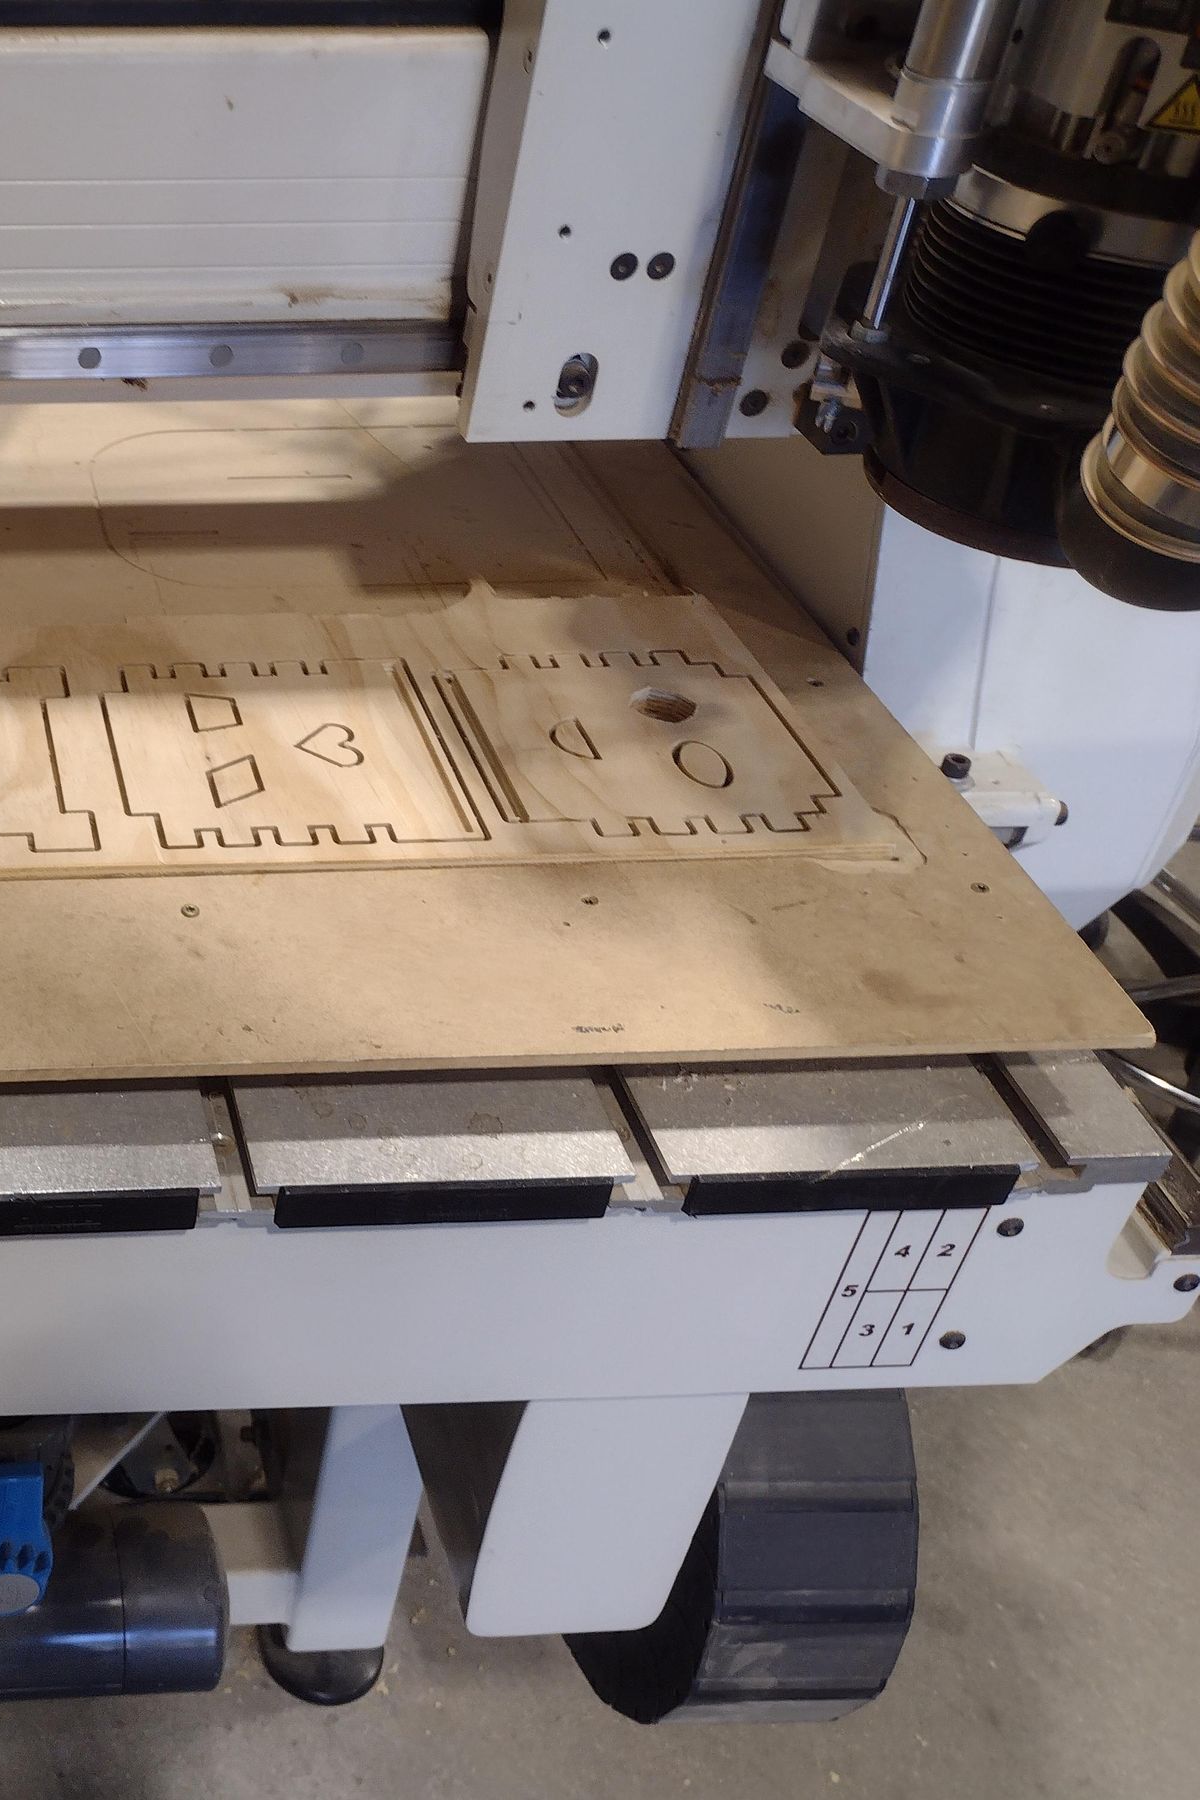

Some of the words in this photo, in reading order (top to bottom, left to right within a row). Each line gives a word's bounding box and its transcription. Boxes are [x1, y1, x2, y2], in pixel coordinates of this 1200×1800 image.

[894, 1244, 912, 1258] 4
[936, 1243, 956, 1257] 2
[840, 1284, 859, 1298] 5
[858, 1323, 875, 1337] 3
[902, 1322, 915, 1336] 1
